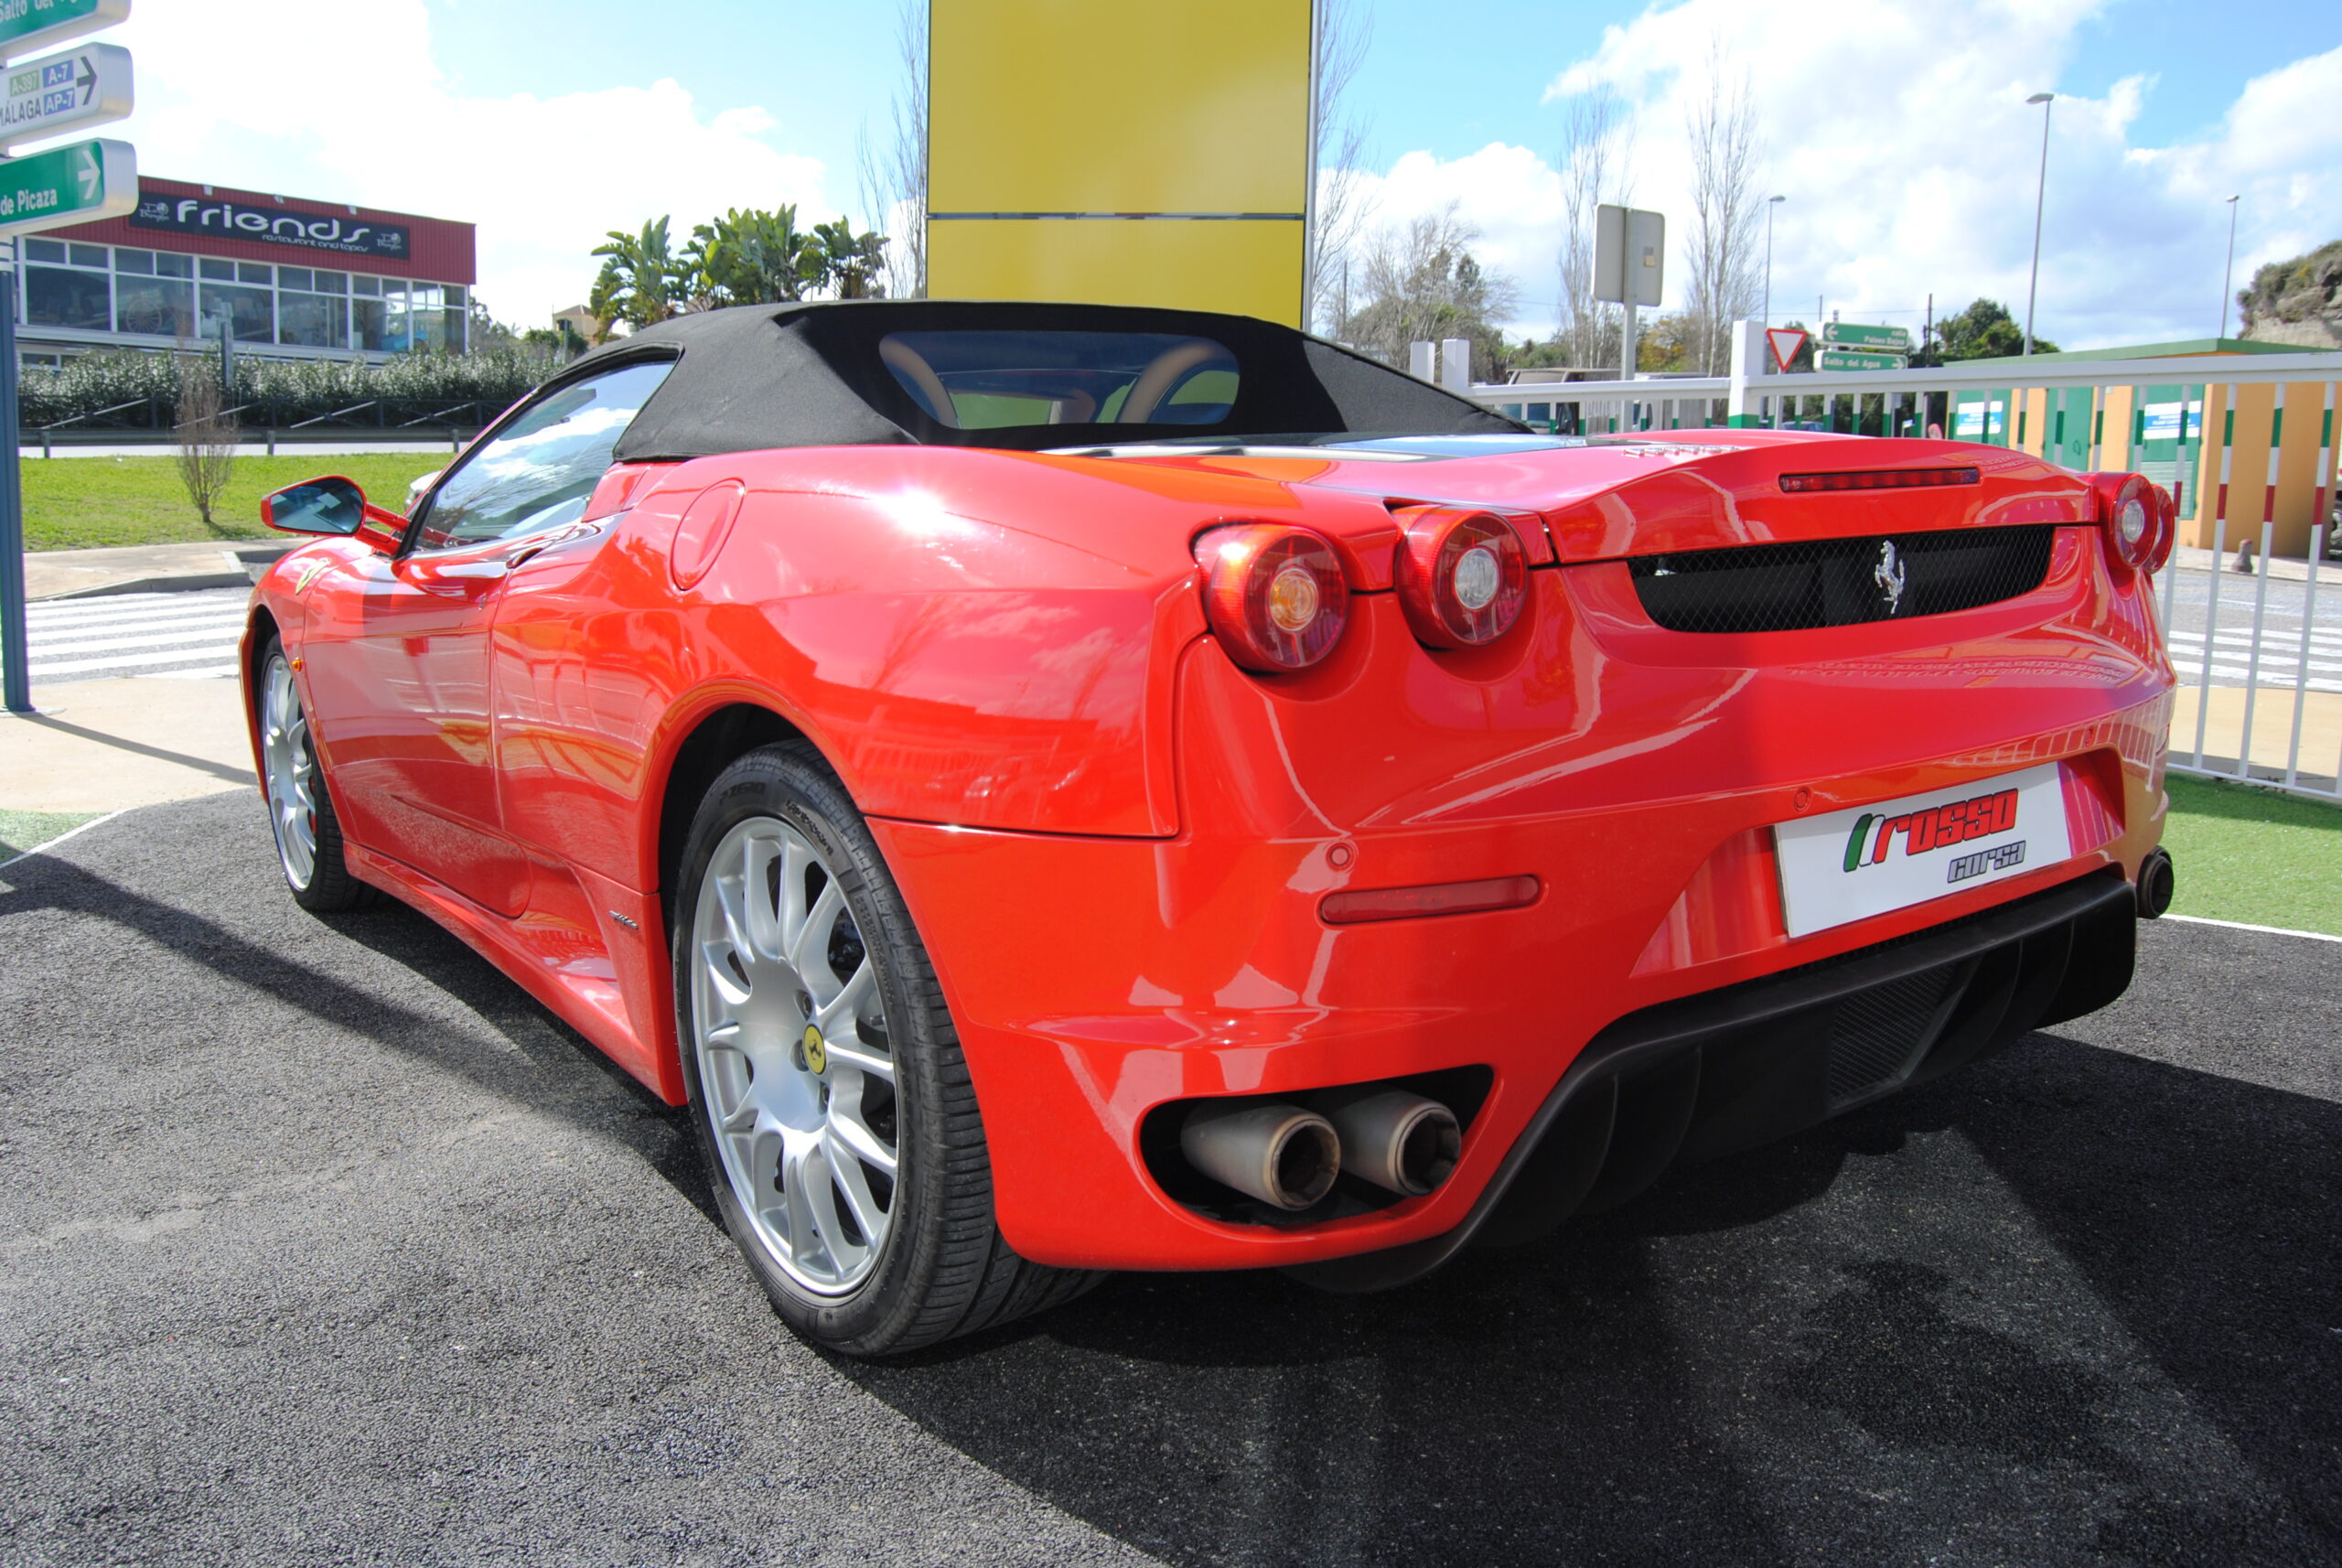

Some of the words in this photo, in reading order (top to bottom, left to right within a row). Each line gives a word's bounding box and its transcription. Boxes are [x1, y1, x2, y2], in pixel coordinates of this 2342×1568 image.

[11, 71, 38, 96] A-397
[48, 63, 69, 85] A-7
[46, 90, 74, 113] AP-7
[0, 194, 15, 216] de
[17, 188, 58, 212] Picaza
[262, 234, 317, 247] restaurant
[317, 241, 339, 250] and
[340, 243, 370, 252] tapas
[1823, 357, 1844, 366] Salto
[1847, 359, 1859, 367] del
[1862, 359, 1881, 370] Agua
[1947, 840, 2026, 884] corsa
